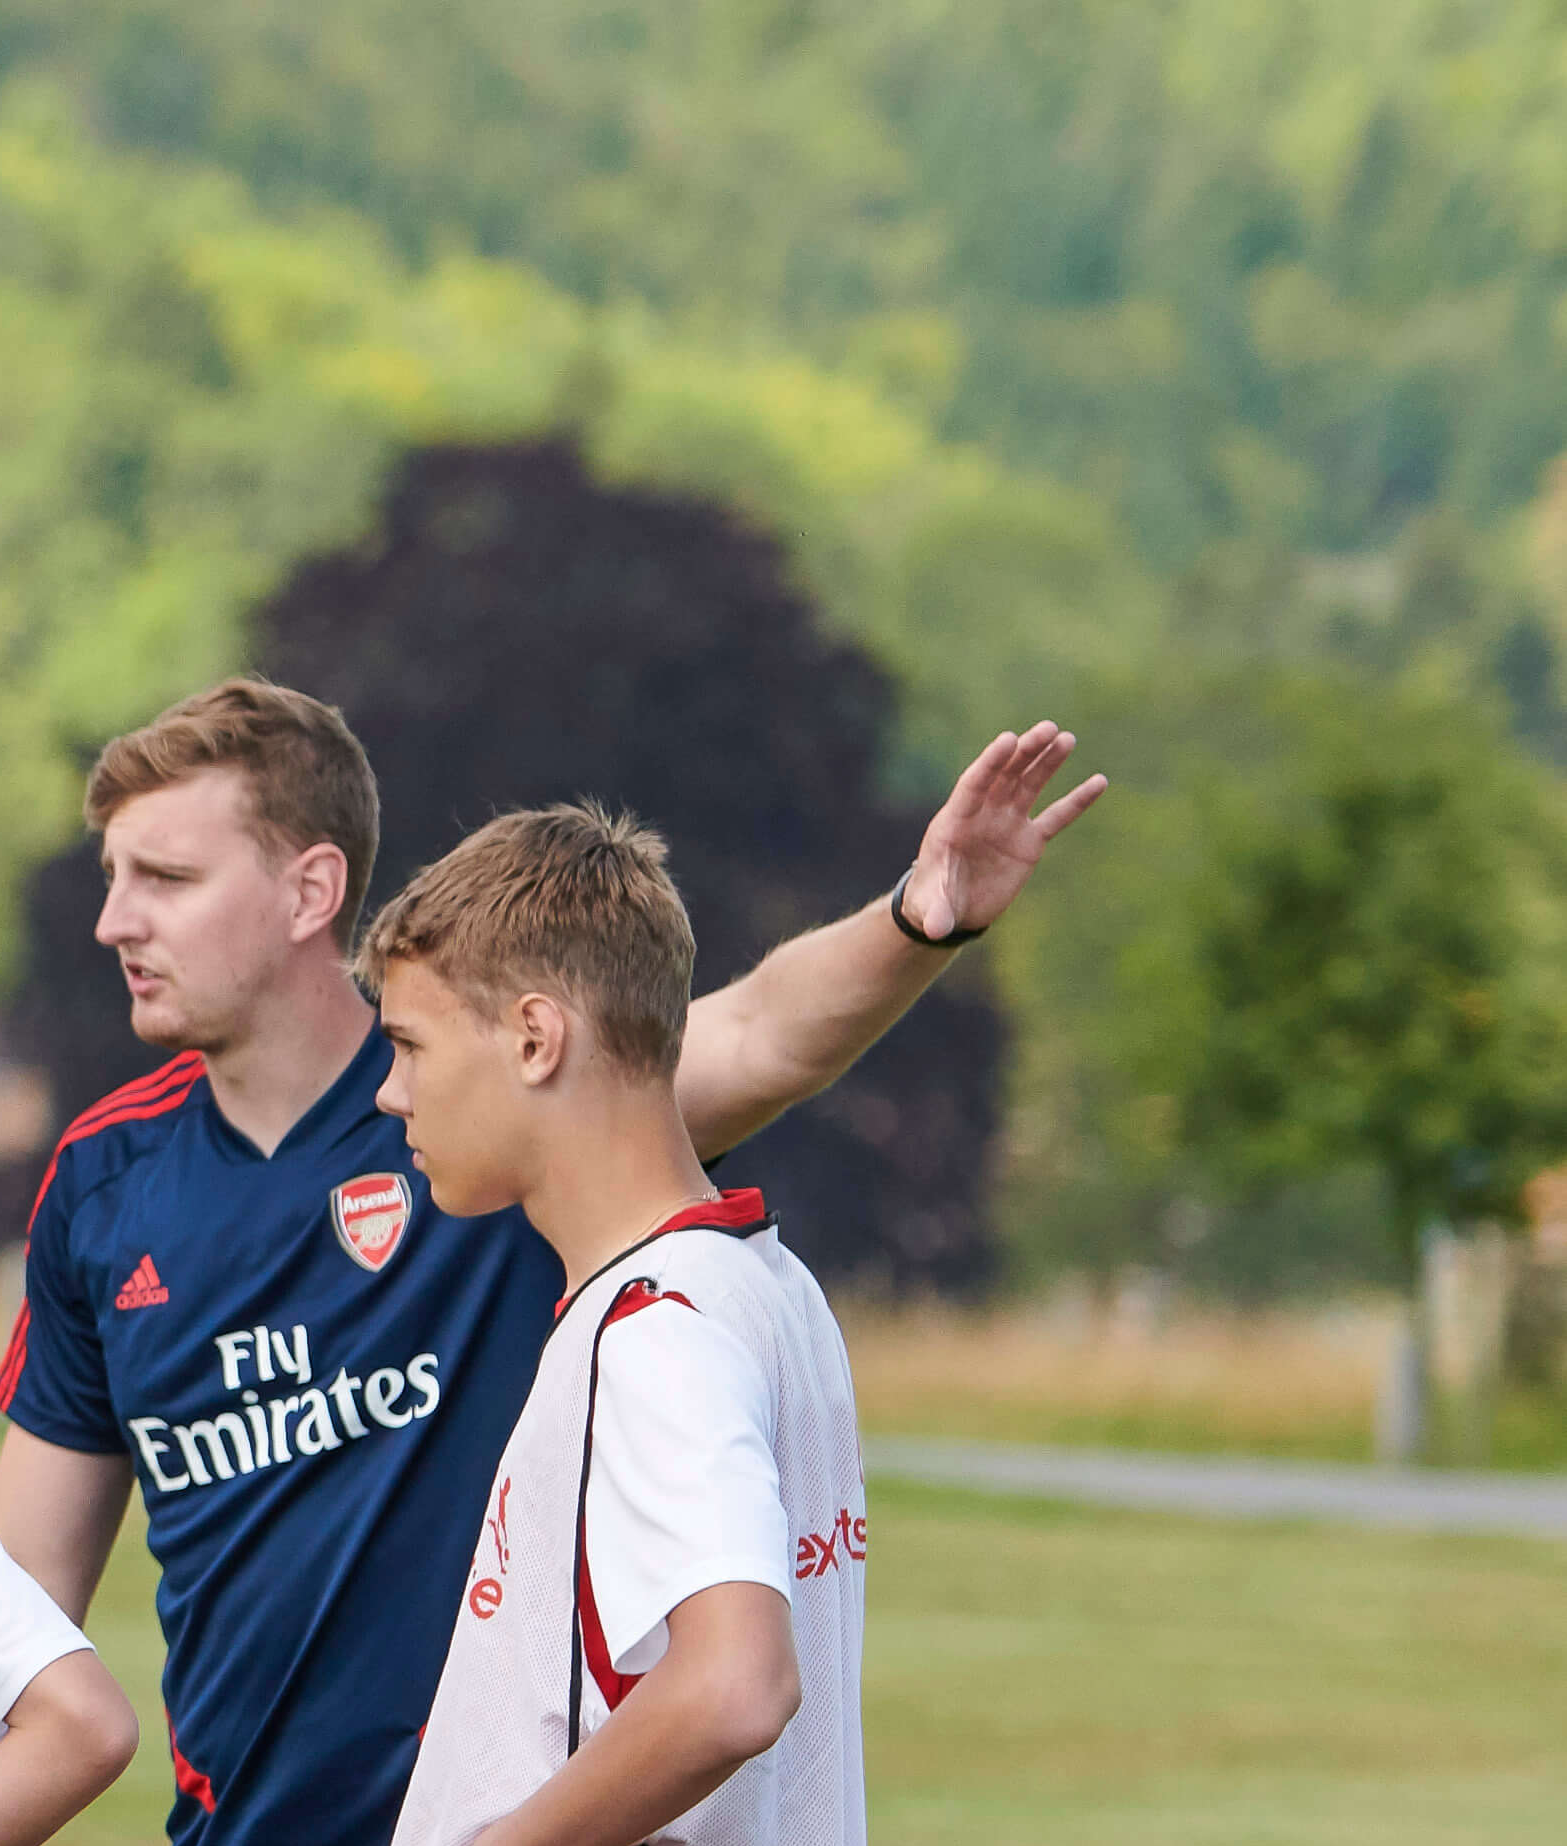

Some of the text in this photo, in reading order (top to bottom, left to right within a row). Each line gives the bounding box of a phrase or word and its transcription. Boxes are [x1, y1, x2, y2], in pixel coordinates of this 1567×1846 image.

[115, 1286, 169, 1311] adidas
[213, 1323, 313, 1390] Fly
[127, 1352, 441, 1492] Emirates
